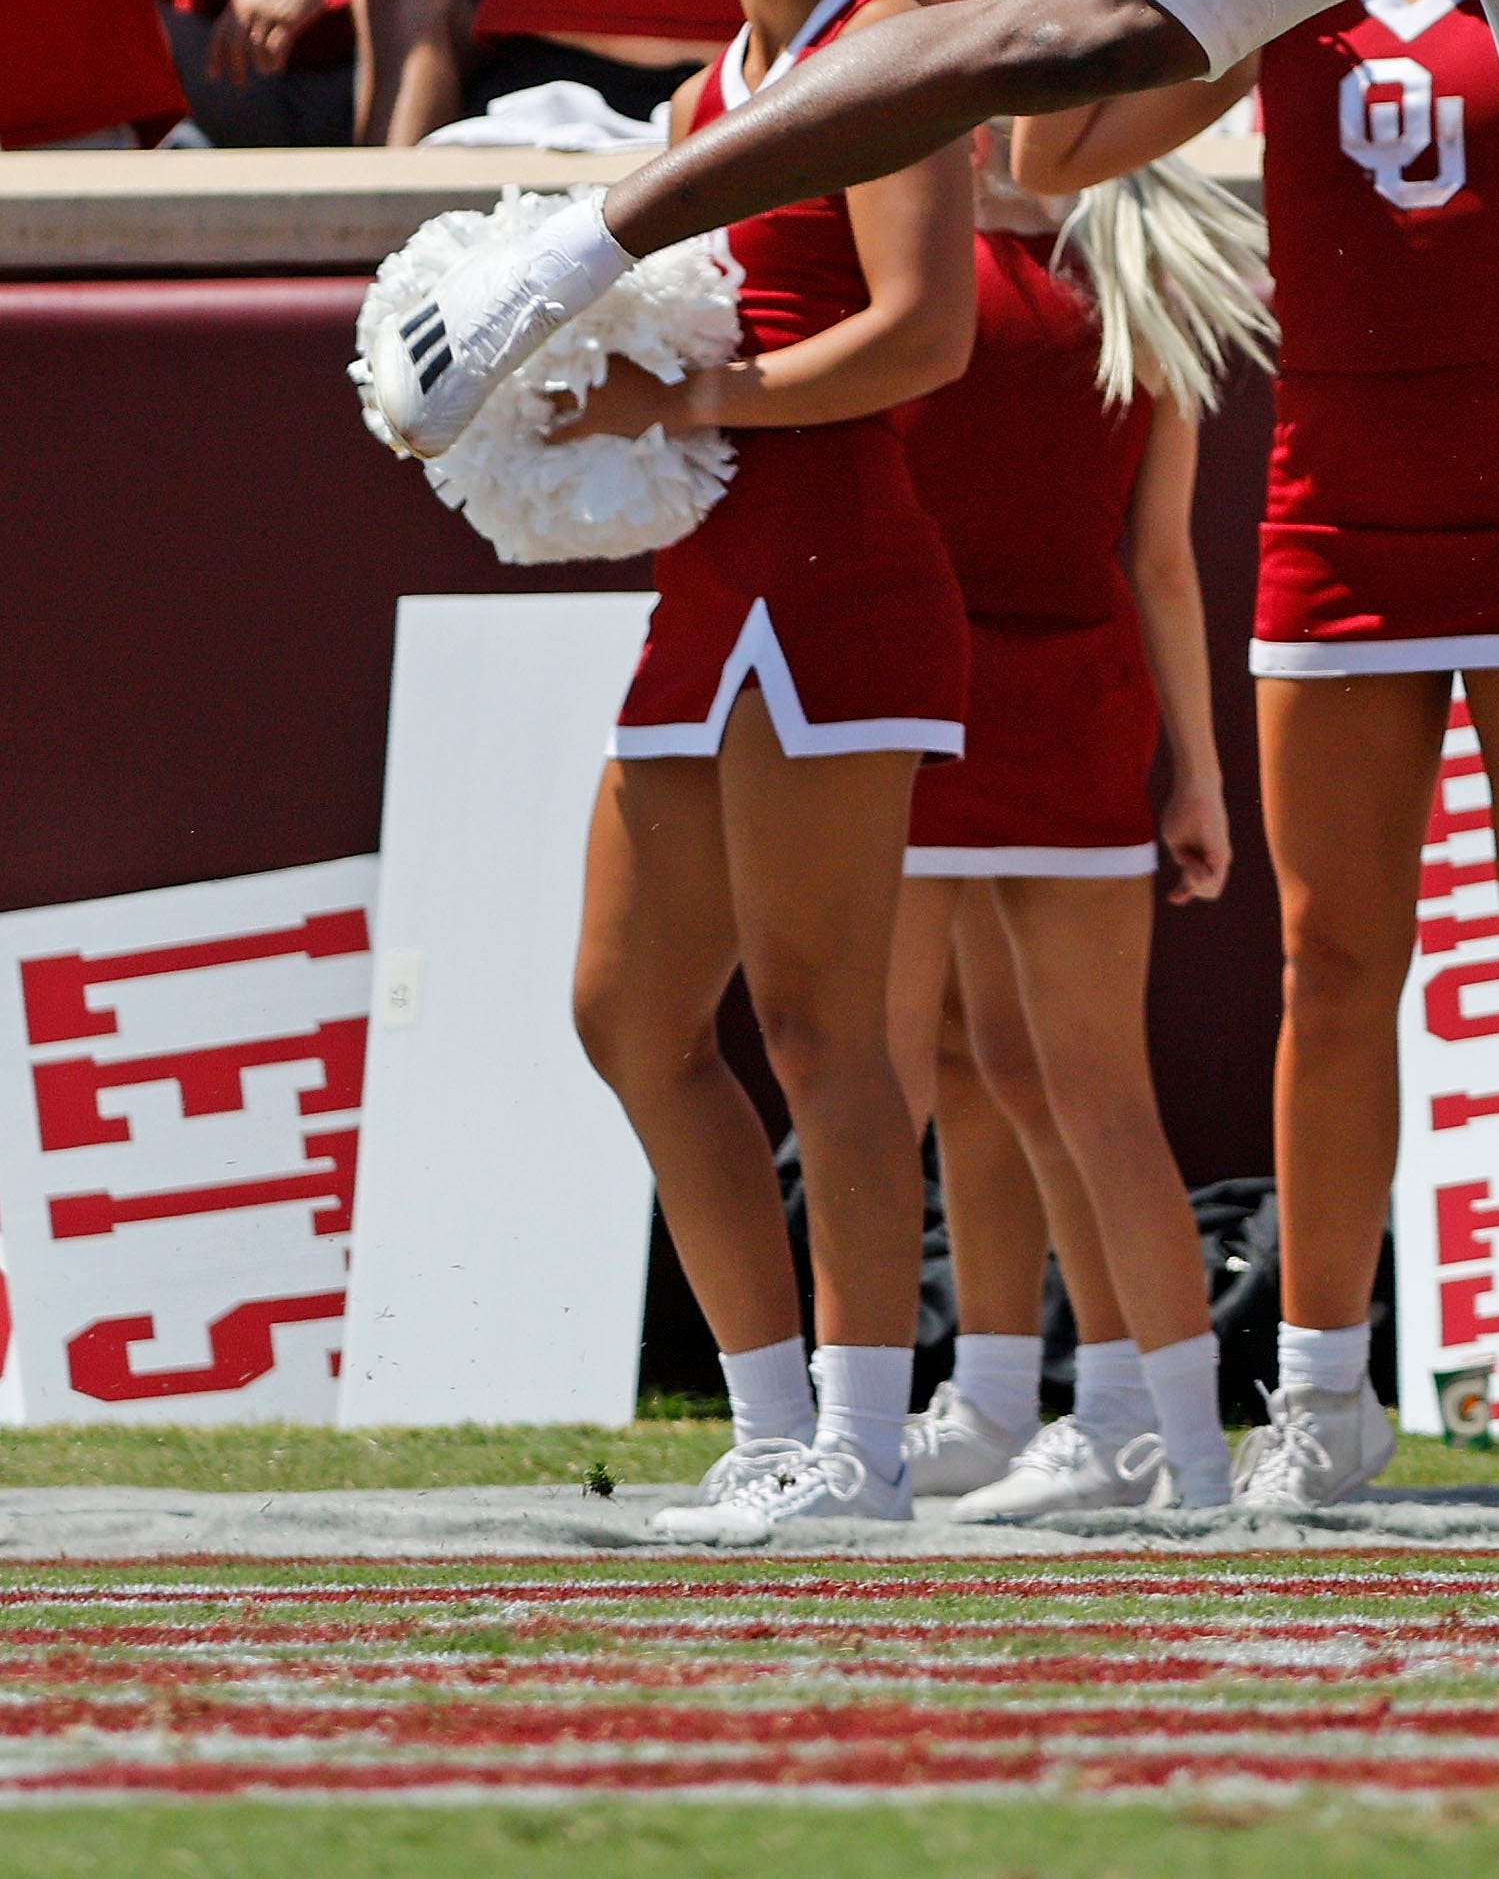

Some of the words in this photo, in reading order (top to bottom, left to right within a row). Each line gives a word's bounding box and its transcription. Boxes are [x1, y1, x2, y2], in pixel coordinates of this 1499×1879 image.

[1338, 56, 1467, 211] OU
[19, 907, 371, 1403] LETS
[1443, 1376, 1490, 1435] G
